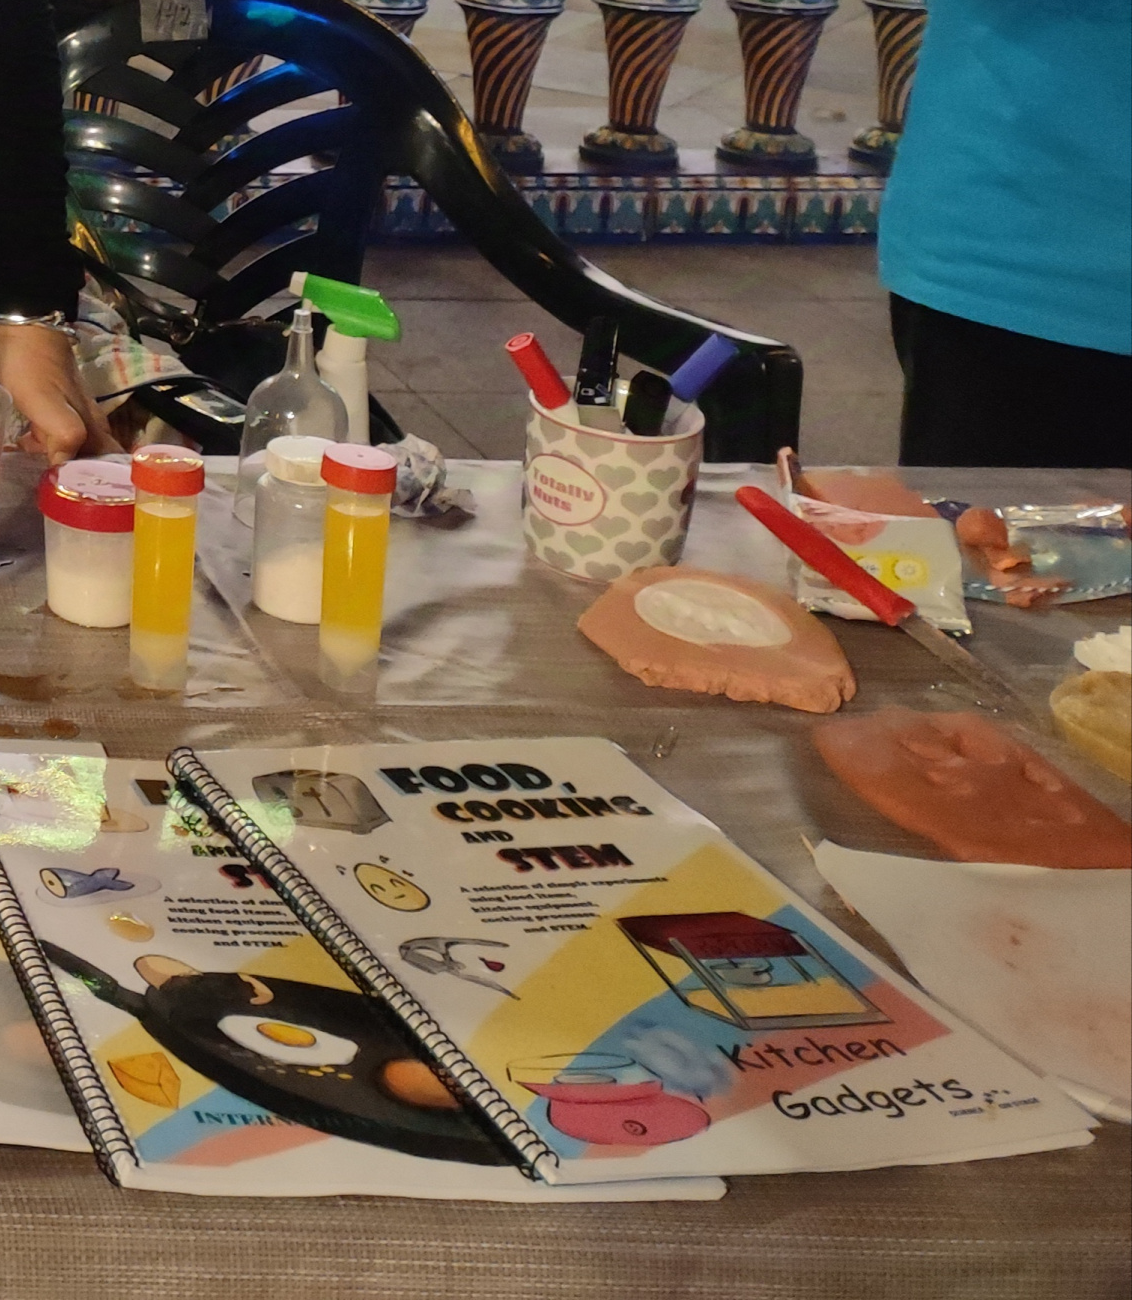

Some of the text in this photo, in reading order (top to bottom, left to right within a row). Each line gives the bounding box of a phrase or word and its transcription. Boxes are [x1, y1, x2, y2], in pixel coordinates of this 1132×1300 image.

[533, 466, 595, 502] Totally
[533, 484, 572, 512] Nuts
[432, 796, 654, 824] COOKING
[461, 830, 514, 843] AND
[496, 843, 635, 874] STEM
[472, 884, 530, 892] selection
[177, 897, 238, 905] selection
[168, 907, 207, 915] using
[208, 907, 240, 915] food
[168, 916, 301, 927] kitchen equipment
[480, 915, 534, 923] cooking
[172, 927, 229, 936] cooking
[717, 1036, 907, 1072] Kitchen
[772, 1077, 974, 1120] Gadgets
